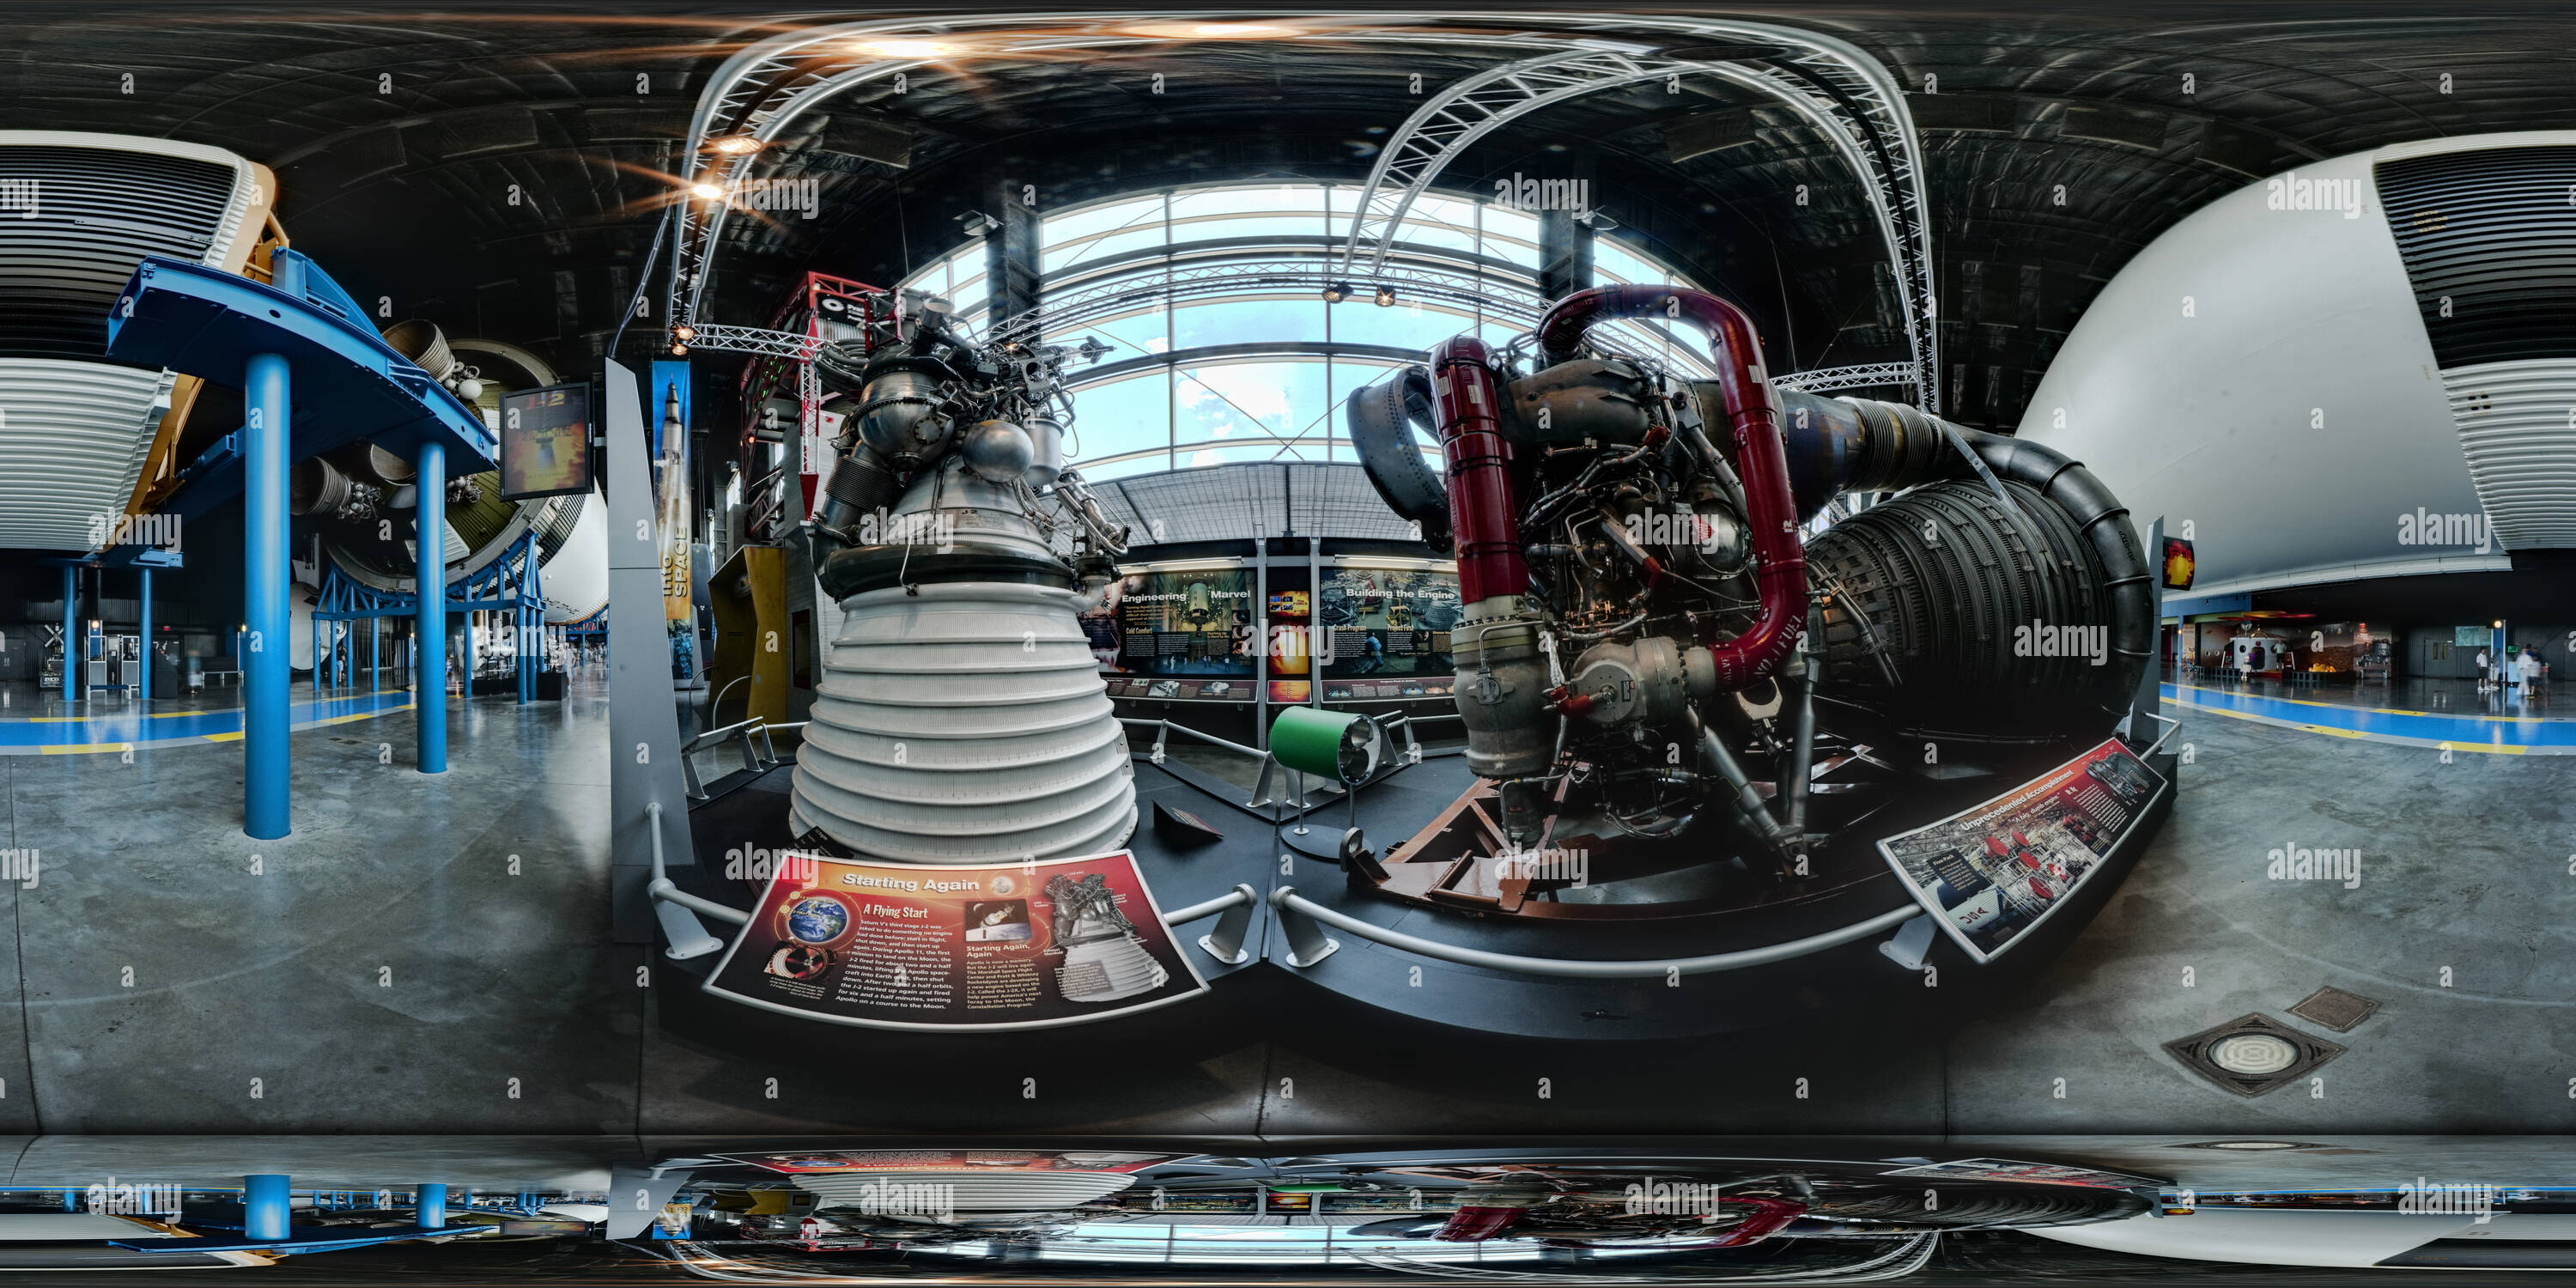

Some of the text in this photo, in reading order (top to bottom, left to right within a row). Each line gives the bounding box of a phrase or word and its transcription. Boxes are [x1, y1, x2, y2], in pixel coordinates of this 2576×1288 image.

[673, 527, 687, 598] SPACE
[1121, 590, 1251, 604] Engineering Marvel
[1346, 588, 1455, 600] Building the Engine
[1777, 615, 1804, 649] FUEL
[1959, 769, 2075, 831] Unprecedented Accomplishment
[2030, 804, 2044, 814] dumb
[843, 873, 980, 893] Starting Again
[864, 904, 928, 918] A Flying Start
